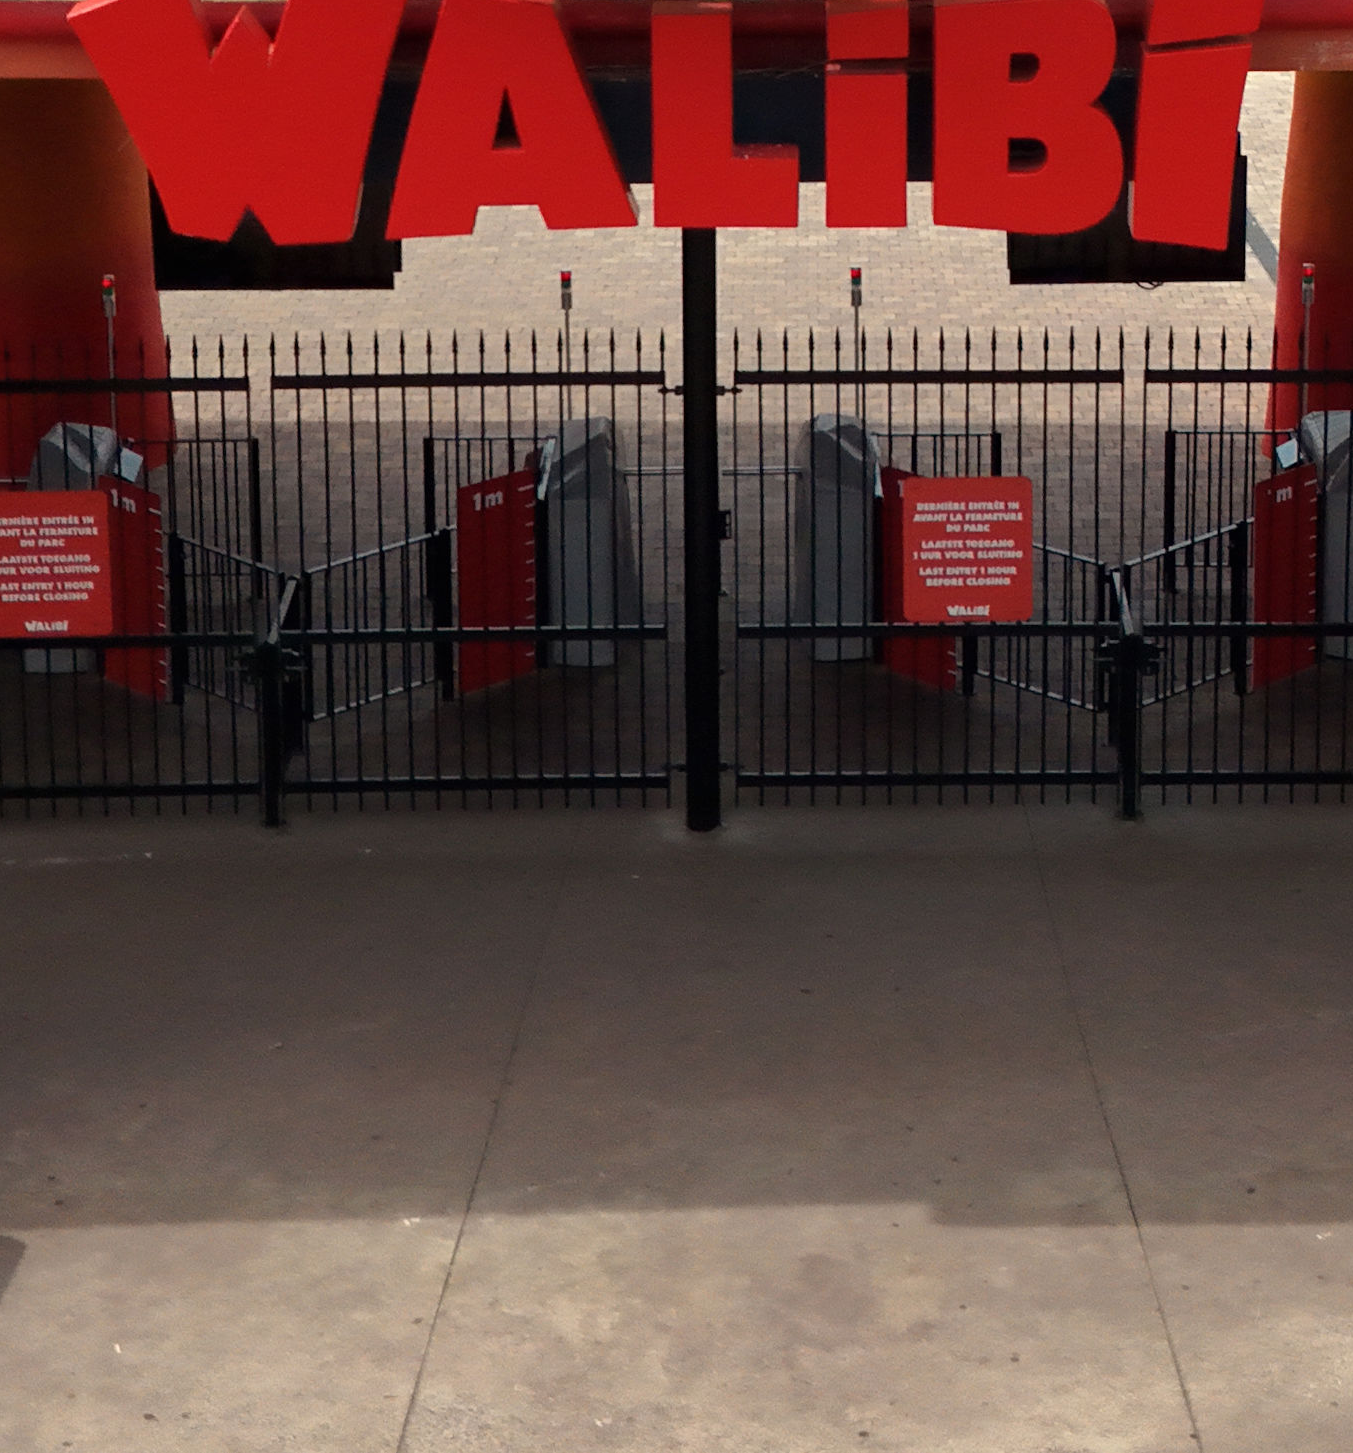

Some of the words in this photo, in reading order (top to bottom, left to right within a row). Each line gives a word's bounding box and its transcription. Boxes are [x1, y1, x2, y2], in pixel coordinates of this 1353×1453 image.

[913, 514, 947, 522] AVANT
[965, 513, 1022, 521] FERMETURE
[39, 527, 98, 536] FERMETURE
[946, 524, 960, 532] DU
[964, 524, 990, 532] PARC
[20, 539, 35, 547] DU
[38, 539, 65, 547] PARC
[945, 551, 974, 559] VOOR
[20, 567, 50, 575] VOOR
[53, 565, 100, 574] SLUITING
[946, 567, 977, 575] ENTRY
[1, 594, 40, 602] BEFORE
[43, 592, 88, 601] CLOSING
